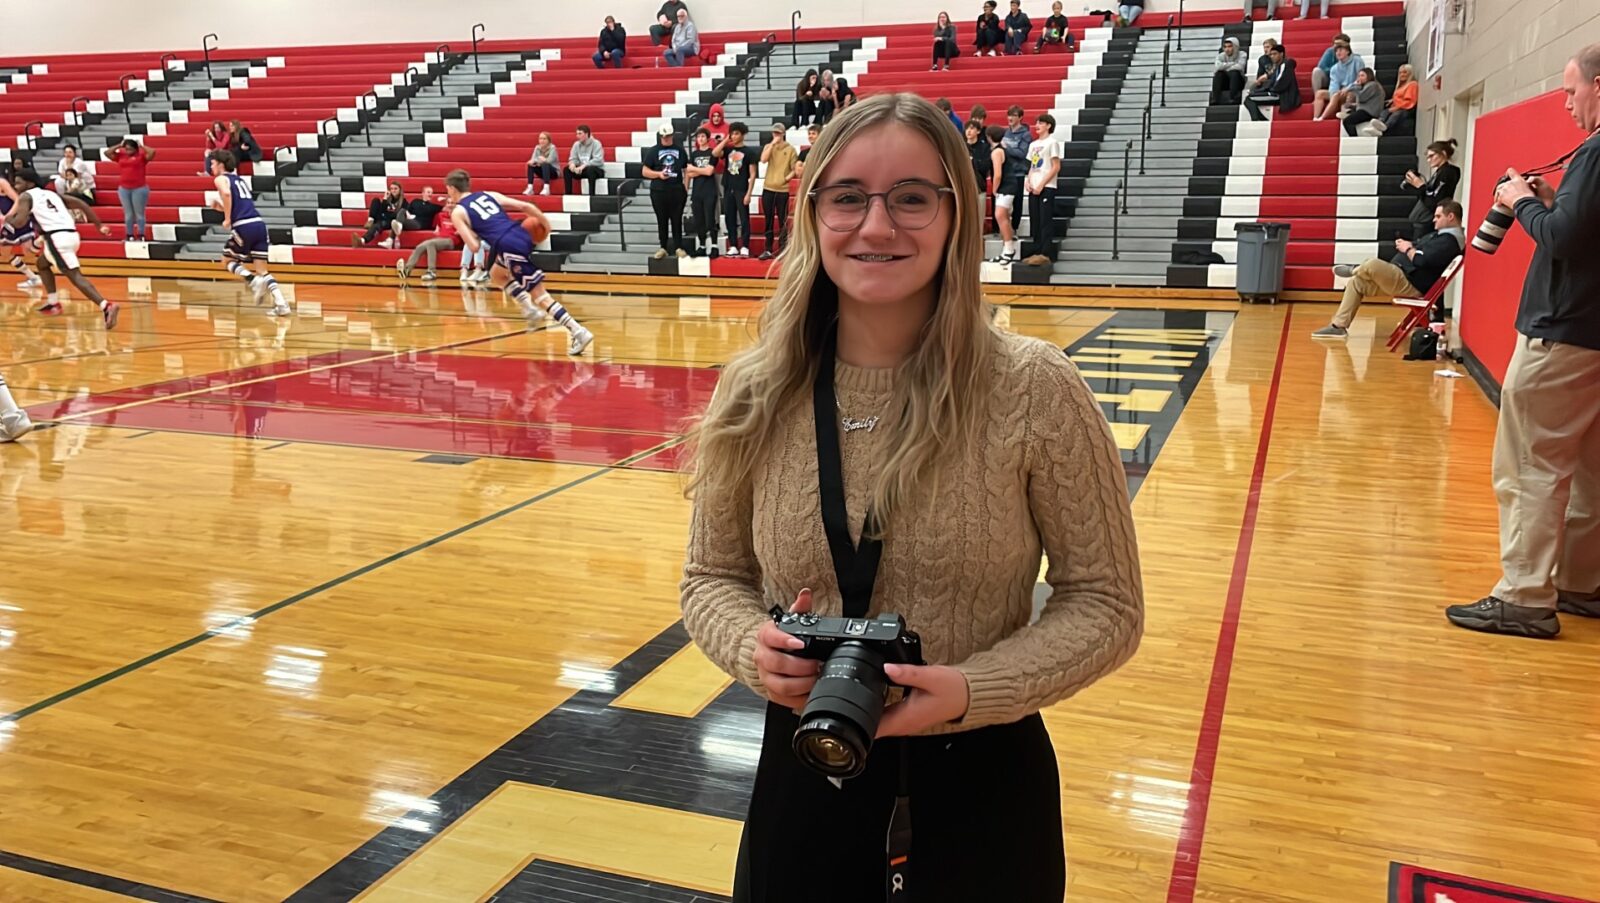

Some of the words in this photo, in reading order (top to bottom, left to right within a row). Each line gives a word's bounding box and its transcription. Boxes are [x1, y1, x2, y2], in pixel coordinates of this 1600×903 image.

[46, 198, 59, 213] 4
[469, 195, 500, 221] 15
[842, 415, 880, 432] Emily
